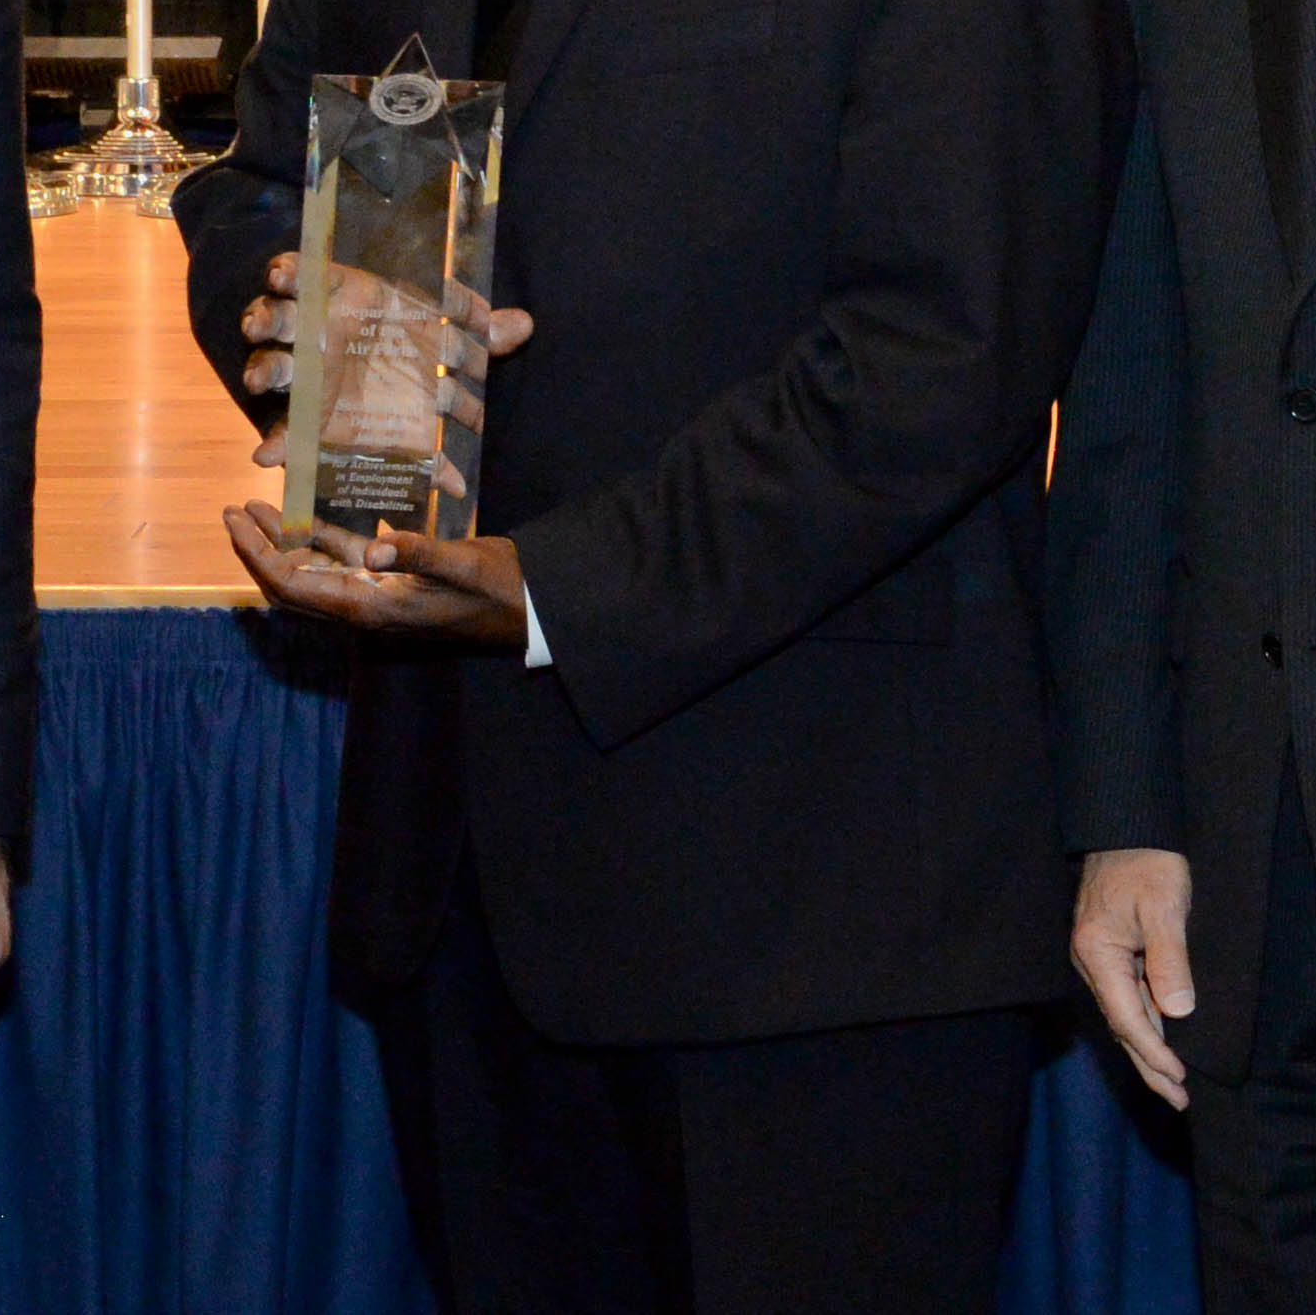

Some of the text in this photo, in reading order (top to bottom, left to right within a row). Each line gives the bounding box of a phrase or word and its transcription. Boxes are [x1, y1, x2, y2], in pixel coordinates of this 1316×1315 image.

[360, 324, 377, 337] of
[346, 341, 373, 355] Air
[349, 471, 413, 485] Employment
[351, 485, 408, 498] Individuals
[355, 499, 415, 512] Disabilities
